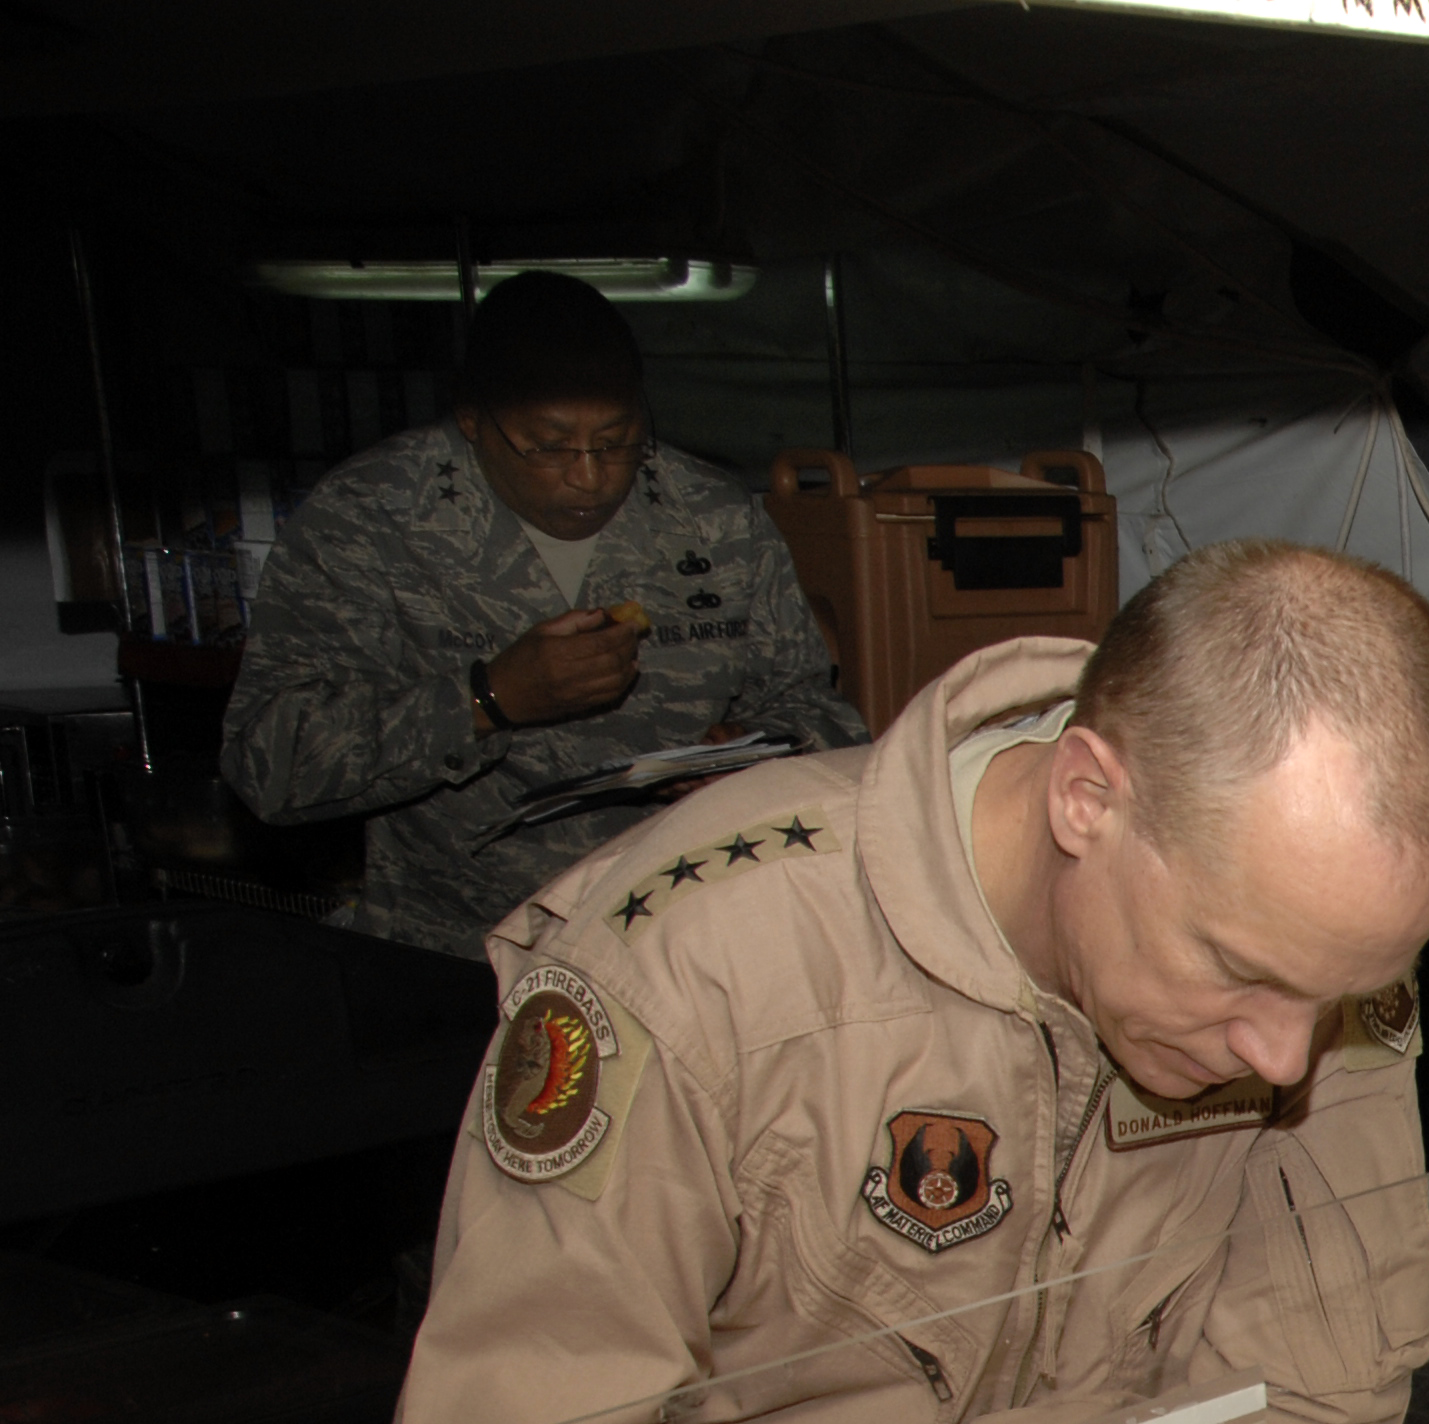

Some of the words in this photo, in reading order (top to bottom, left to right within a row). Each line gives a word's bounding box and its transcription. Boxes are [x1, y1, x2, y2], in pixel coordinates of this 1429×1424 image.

[511, 971, 541, 1008] C-21
[544, 969, 611, 1041] FIREBASS
[1117, 1109, 1183, 1138] DONALD
[1191, 1096, 1272, 1124] HOFFMAN
[536, 1115, 604, 1174] TOMORROW
[872, 1194, 890, 1211] AF
[942, 1204, 1001, 1244] COMMAND
